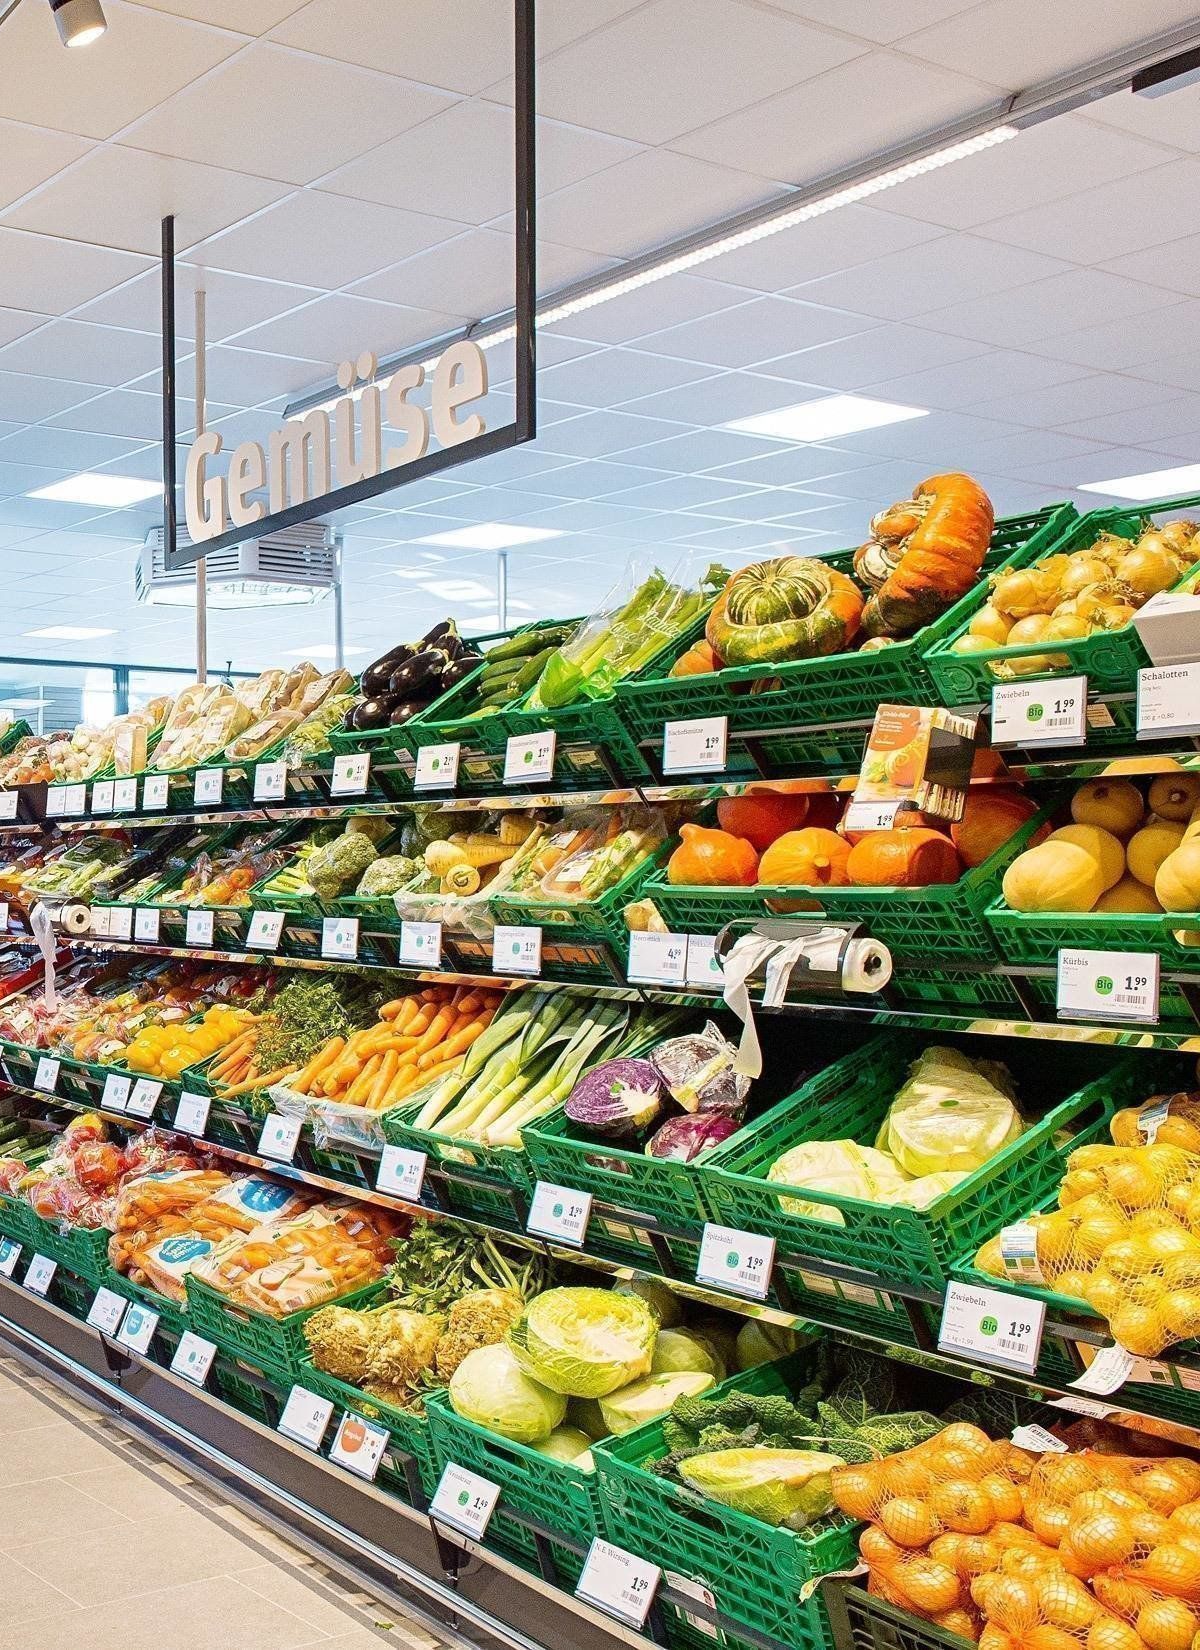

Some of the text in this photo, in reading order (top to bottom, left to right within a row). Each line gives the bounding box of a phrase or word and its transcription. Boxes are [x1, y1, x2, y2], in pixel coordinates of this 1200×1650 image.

[185, 340, 488, 543] Gemüse
[1141, 670, 1189, 682] Schalotten
[995, 690, 1030, 700] Zwiebeln
[1028, 707, 1043, 718] Bio
[1054, 699, 1075, 714] 1.99
[705, 737, 720, 749] 1.99
[667, 948, 682, 960] 4.99
[1062, 957, 1089, 966] Kürbis
[1096, 979, 1114, 990] Bio
[1124, 976, 1147, 991] 1.99
[569, 1205, 583, 1218] 1.99
[746, 1256, 764, 1270] 1.99
[950, 1291, 986, 1307] Zwiebeln
[981, 1320, 998, 1333] Bio
[1008, 1321, 1031, 1338] 1.99
[473, 1497, 488, 1510] 1.49
[607, 1549, 631, 1567] Wirsing
[630, 1577, 649, 1592] 1.99
